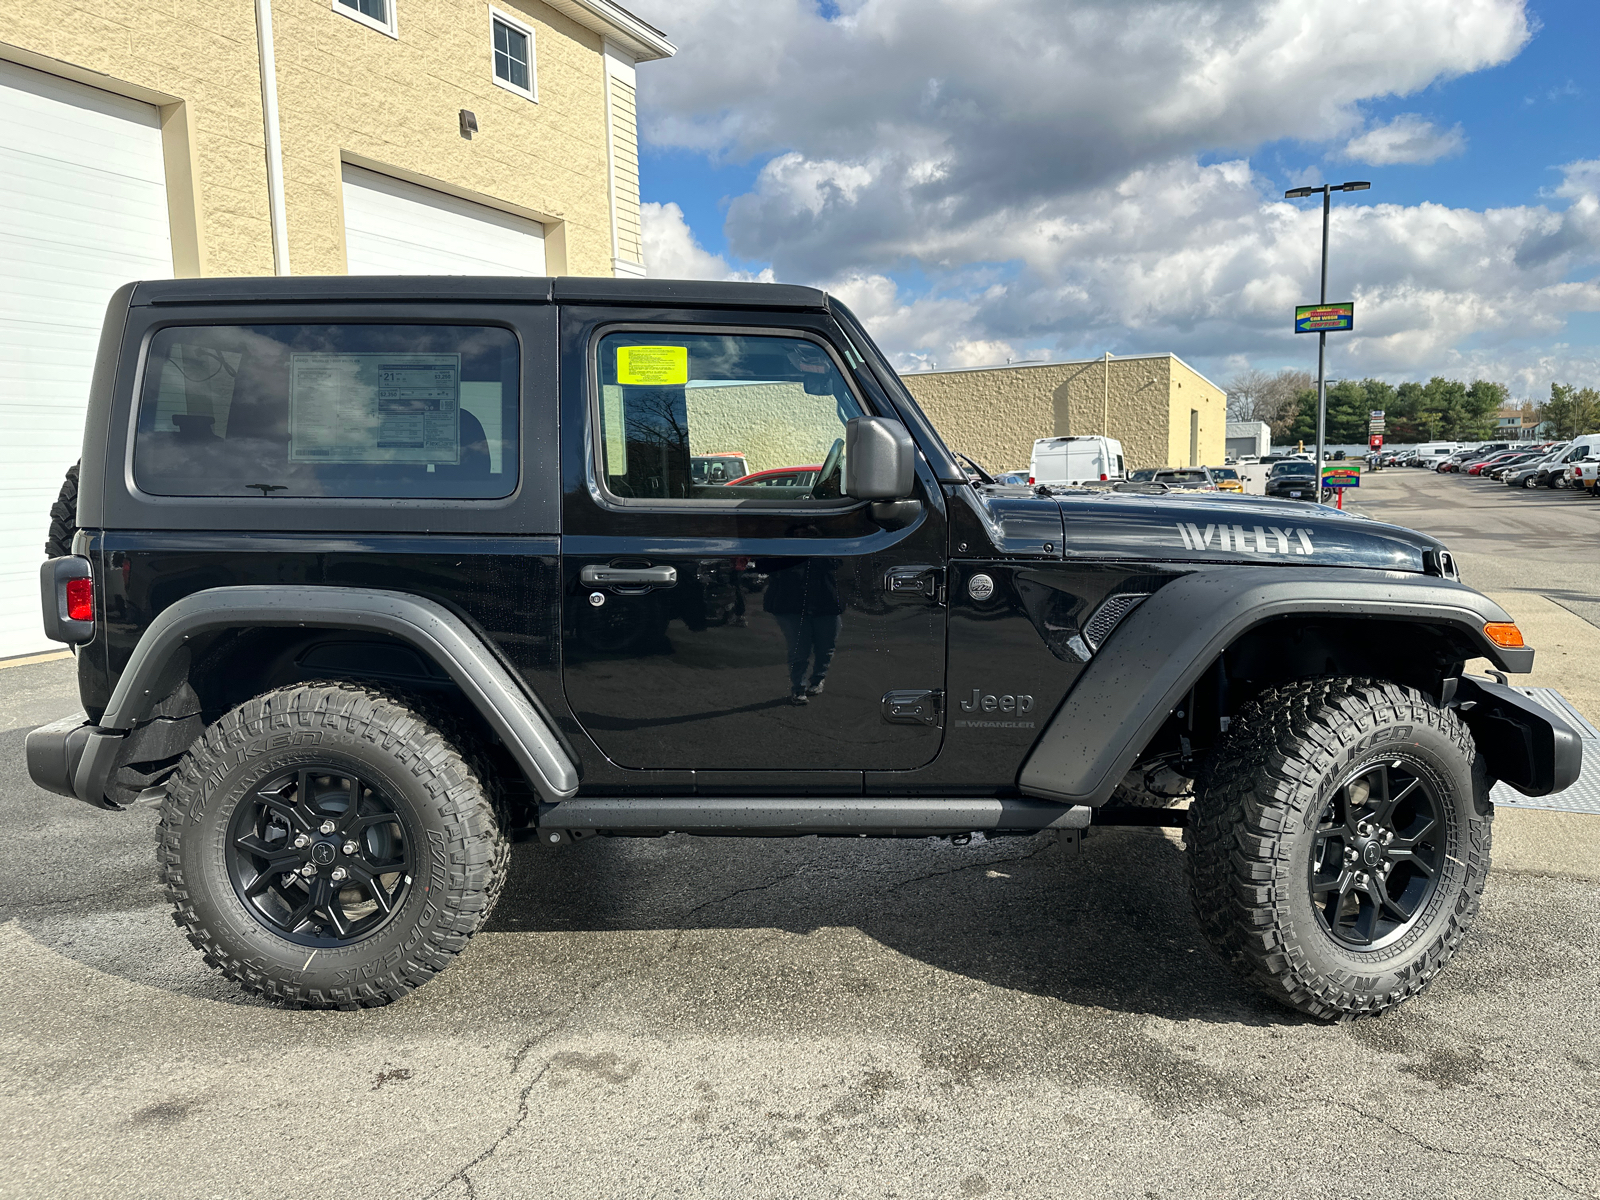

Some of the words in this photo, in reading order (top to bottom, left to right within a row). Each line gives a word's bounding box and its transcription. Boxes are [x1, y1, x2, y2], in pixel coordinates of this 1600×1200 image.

[384, 373, 395, 381] 21
[1176, 522, 1314, 555] WILLYS
[960, 688, 1034, 717] Jeep
[966, 720, 1036, 729] WRANGLER
[189, 730, 325, 827] FALKEN
[1303, 725, 1414, 834] FALKEN
[333, 829, 449, 982] WILDPEAK
[242, 954, 318, 986] M/T
[1325, 968, 1383, 993] M/T
